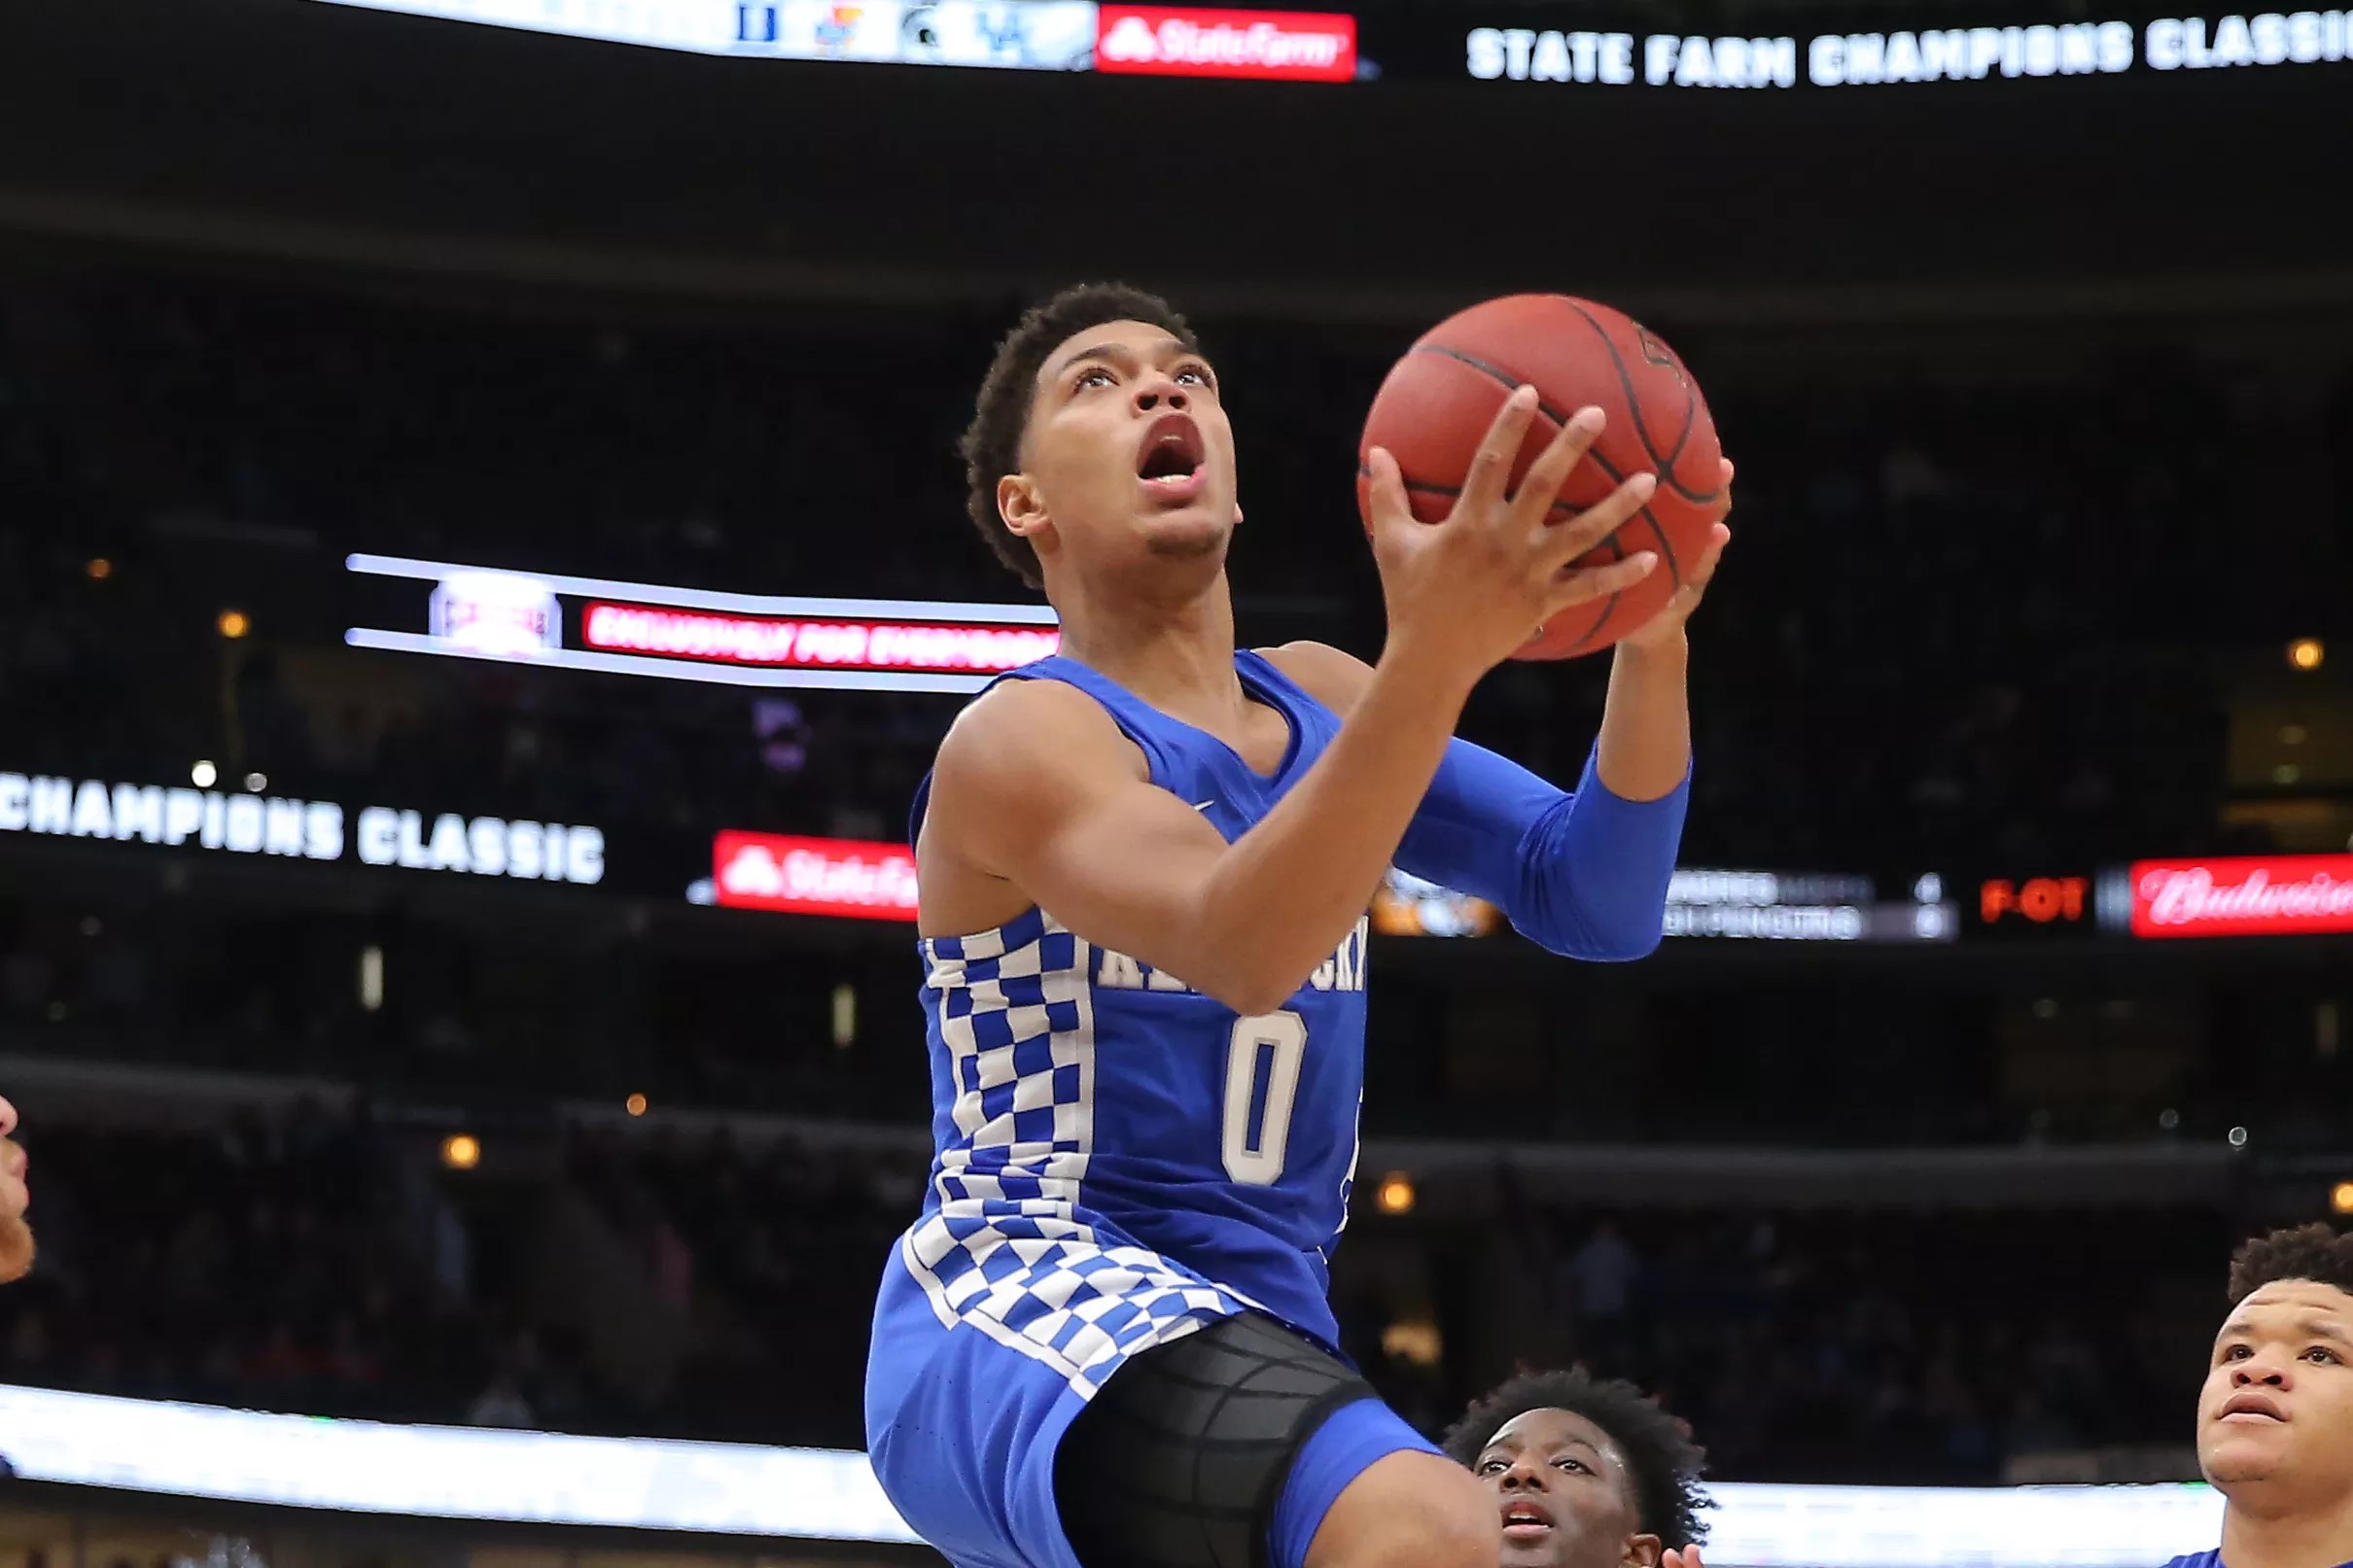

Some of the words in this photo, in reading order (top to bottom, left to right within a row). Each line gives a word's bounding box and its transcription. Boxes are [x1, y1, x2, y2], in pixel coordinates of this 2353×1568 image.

[1466, 28, 1634, 85] STATE
[1644, 34, 1797, 88] FARM
[1809, 20, 2134, 87] CHAMPIONS
[2146, 9, 2353, 71] CLASSI
[0, 772, 344, 860] CHAMPIONS
[357, 806, 605, 885] CLASSIC
[1222, 1008, 1309, 1186] 0
